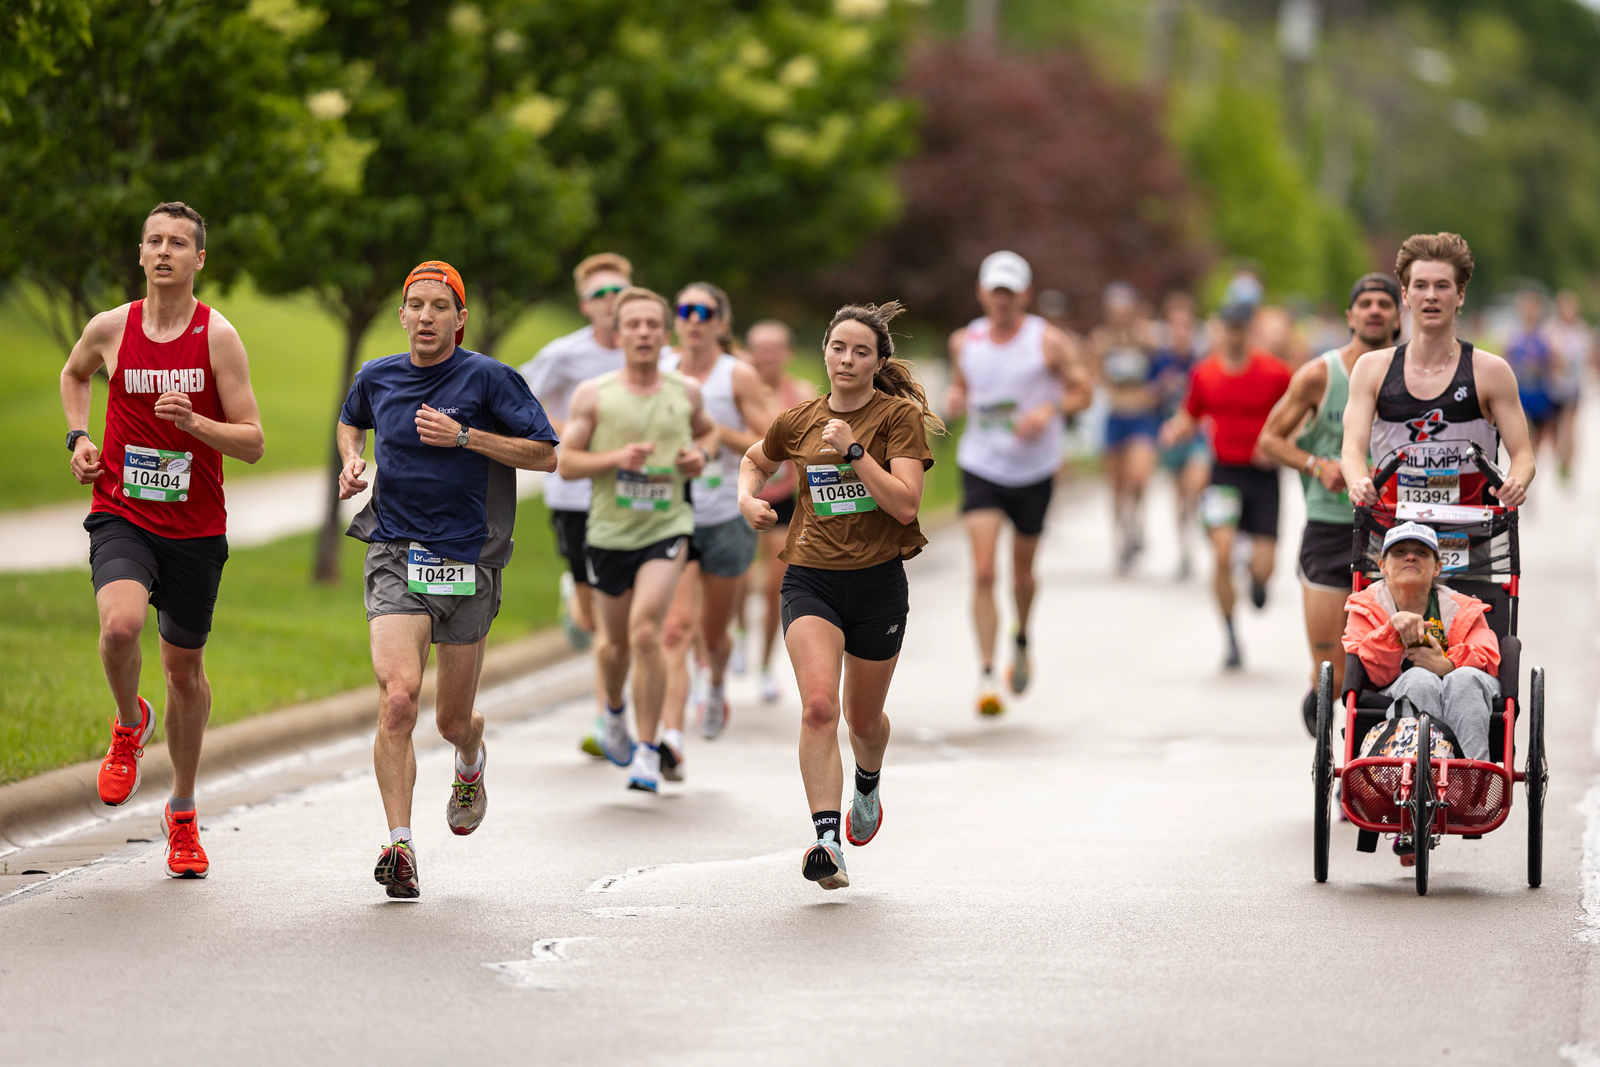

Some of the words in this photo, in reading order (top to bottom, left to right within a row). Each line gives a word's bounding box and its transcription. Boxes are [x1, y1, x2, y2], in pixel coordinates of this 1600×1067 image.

[124, 368, 205, 393] UNATTACHED
[132, 470, 180, 489] 10404
[817, 484, 866, 502] 10488
[1404, 489, 1450, 503] 13394
[1440, 552, 1460, 566] 52
[416, 567, 464, 583] 10421
[814, 817, 837, 826] ANDIT
